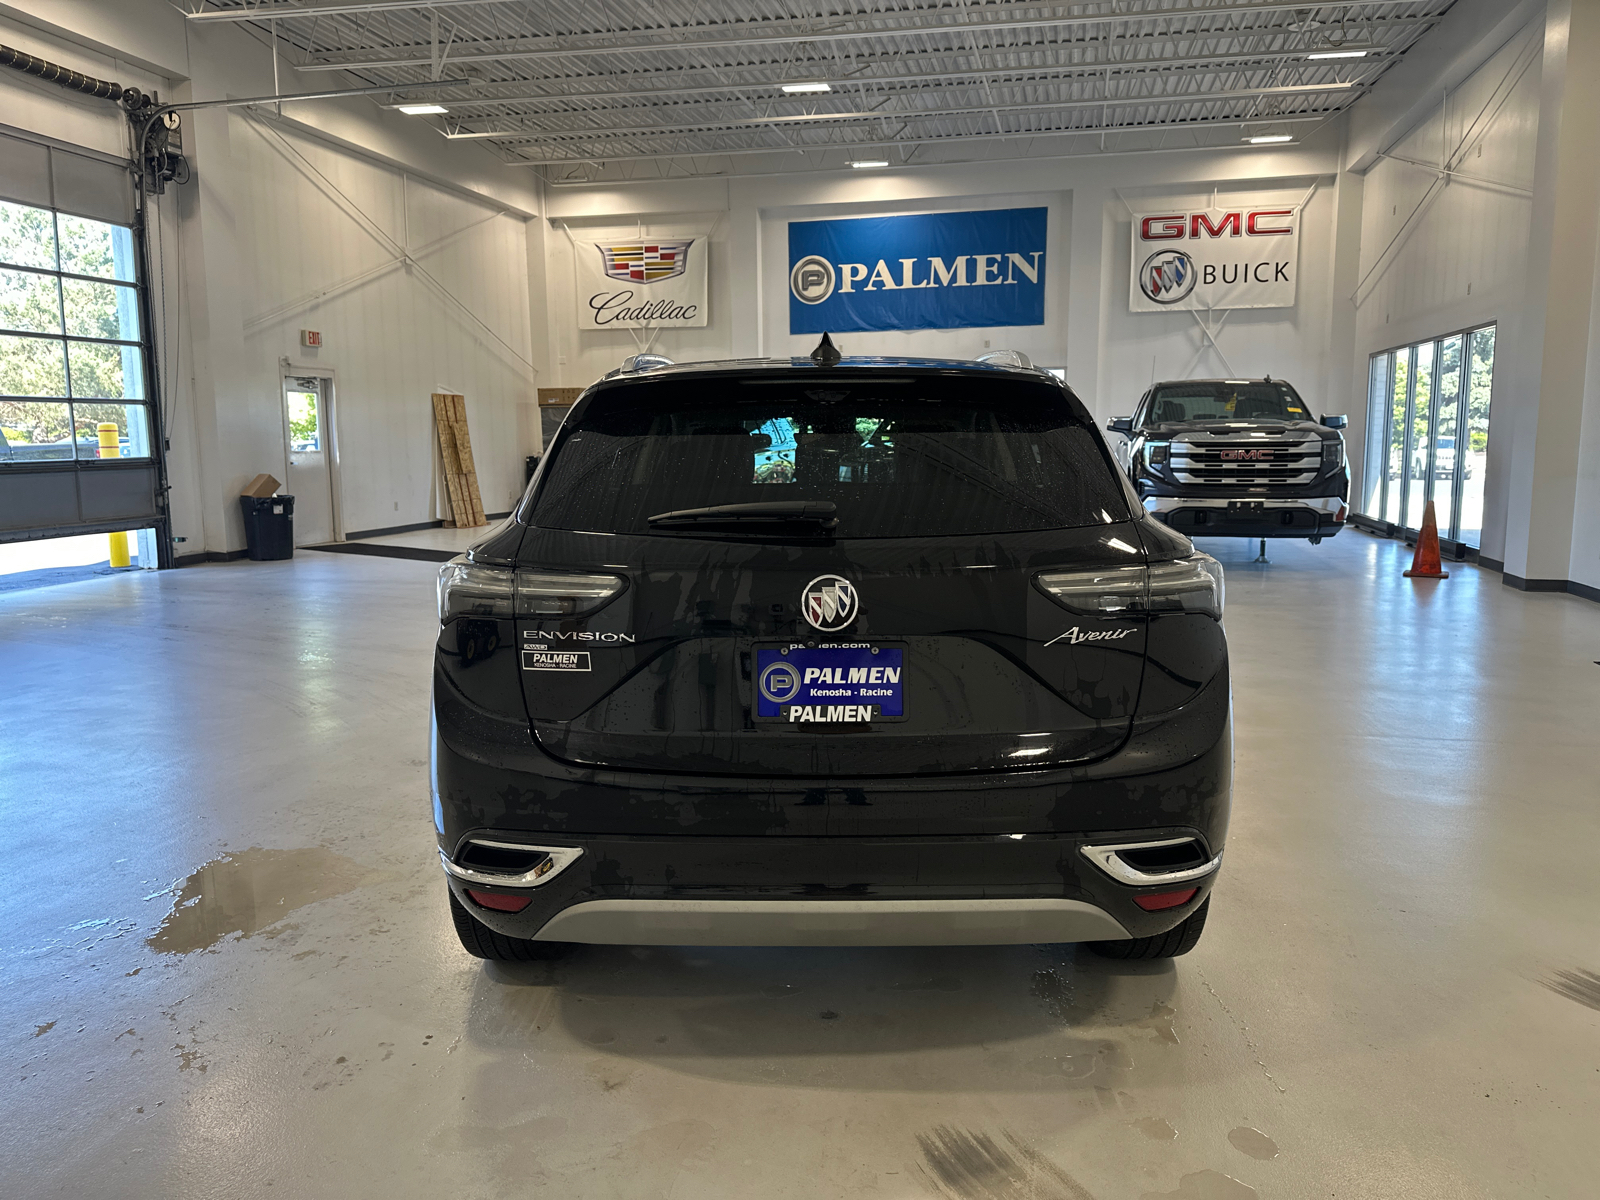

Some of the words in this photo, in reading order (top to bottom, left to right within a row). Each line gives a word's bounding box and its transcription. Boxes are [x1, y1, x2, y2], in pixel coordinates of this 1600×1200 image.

[1140, 208, 1294, 241] GMC
[837, 251, 1044, 293] PALMEN
[1203, 262, 1290, 285] BUICK
[588, 290, 697, 325] Cadillac
[308, 331, 320, 345] EXIT
[1220, 450, 1274, 460] GMC
[523, 630, 635, 642] ENVISION
[1043, 626, 1138, 647] Avenir
[533, 653, 577, 663] PALMEN
[804, 667, 901, 684] PALMEN
[810, 688, 851, 696] Kenosha
[860, 688, 893, 696] Racine
[789, 705, 872, 722] PALMEN
